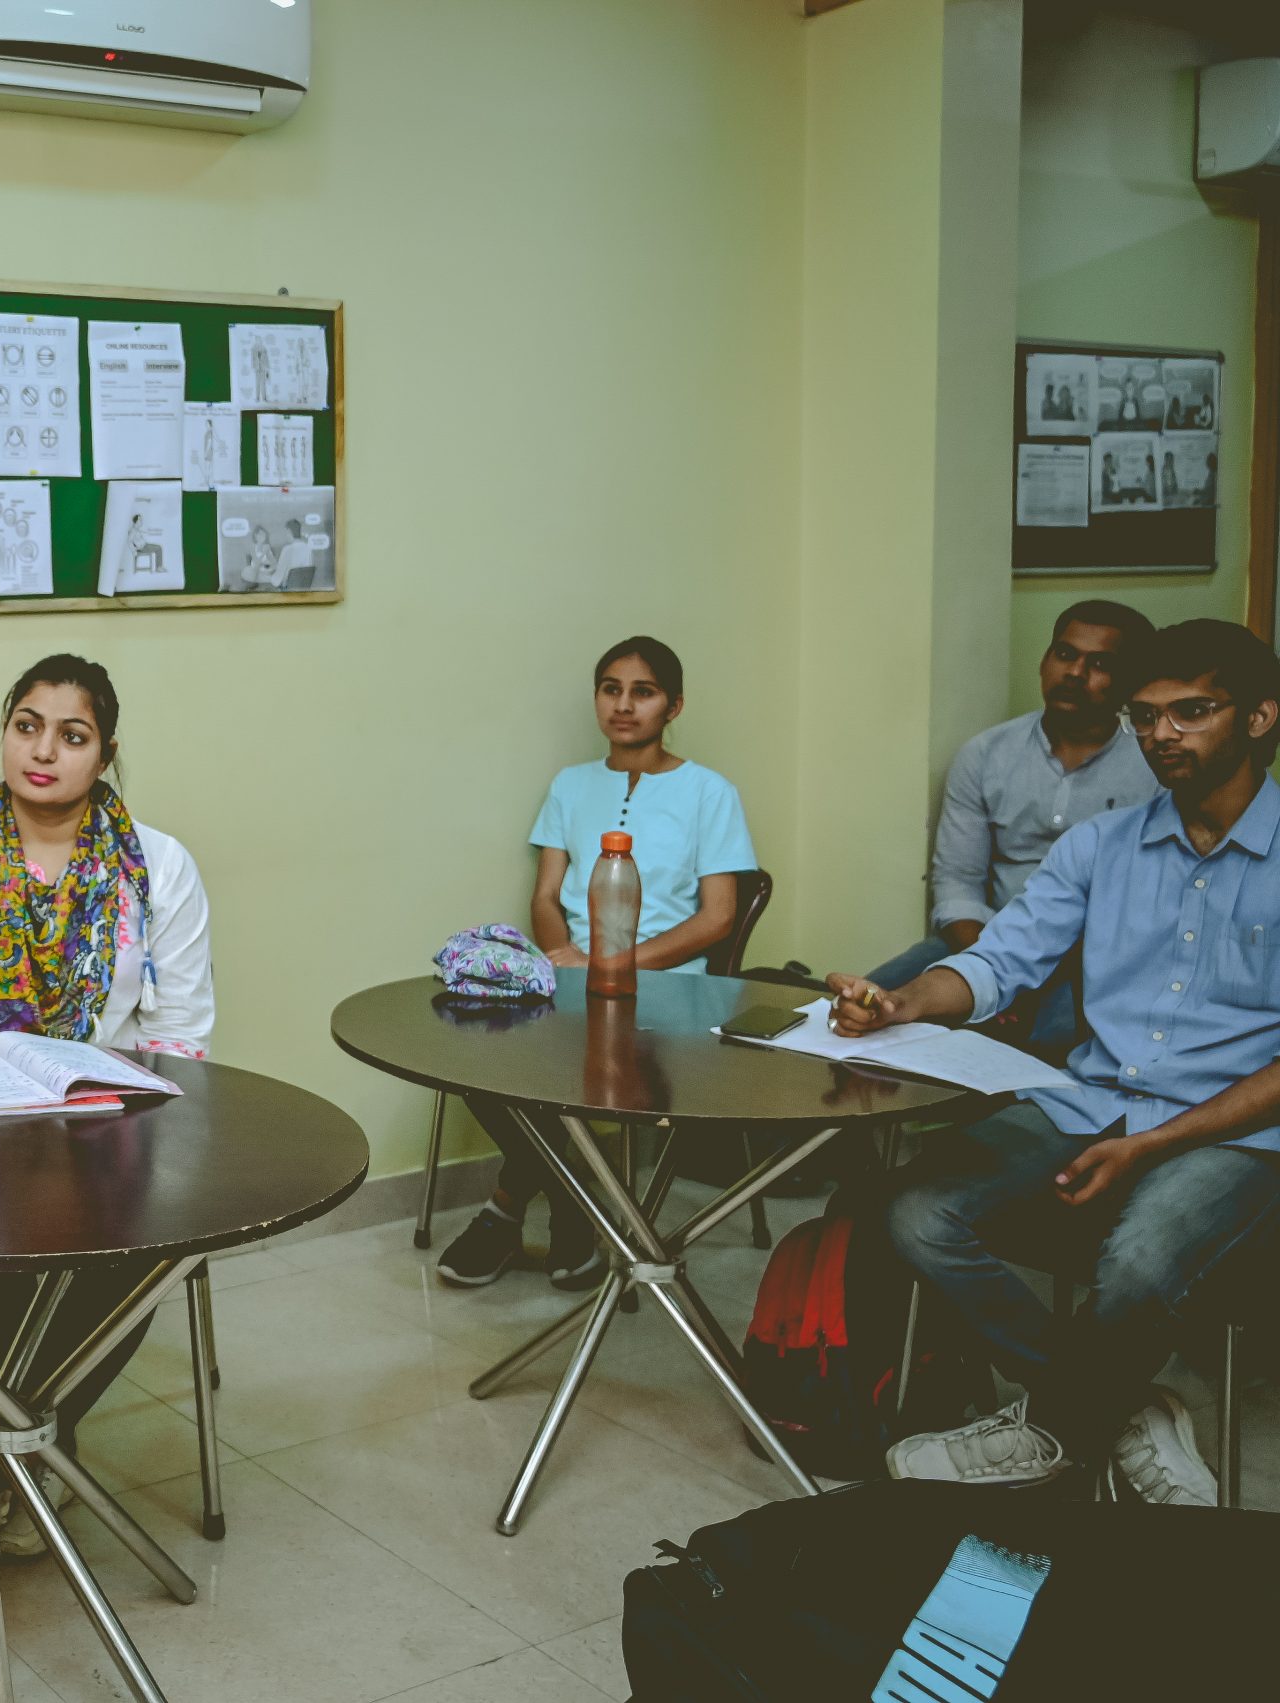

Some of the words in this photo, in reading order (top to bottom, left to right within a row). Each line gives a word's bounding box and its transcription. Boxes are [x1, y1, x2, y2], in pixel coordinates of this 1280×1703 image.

[22, 327, 67, 337] ETIQUETTE
[105, 343, 129, 351] ONLINE
[130, 343, 169, 351] RESOURCES
[99, 361, 127, 372] English
[145, 361, 179, 371] Interview
